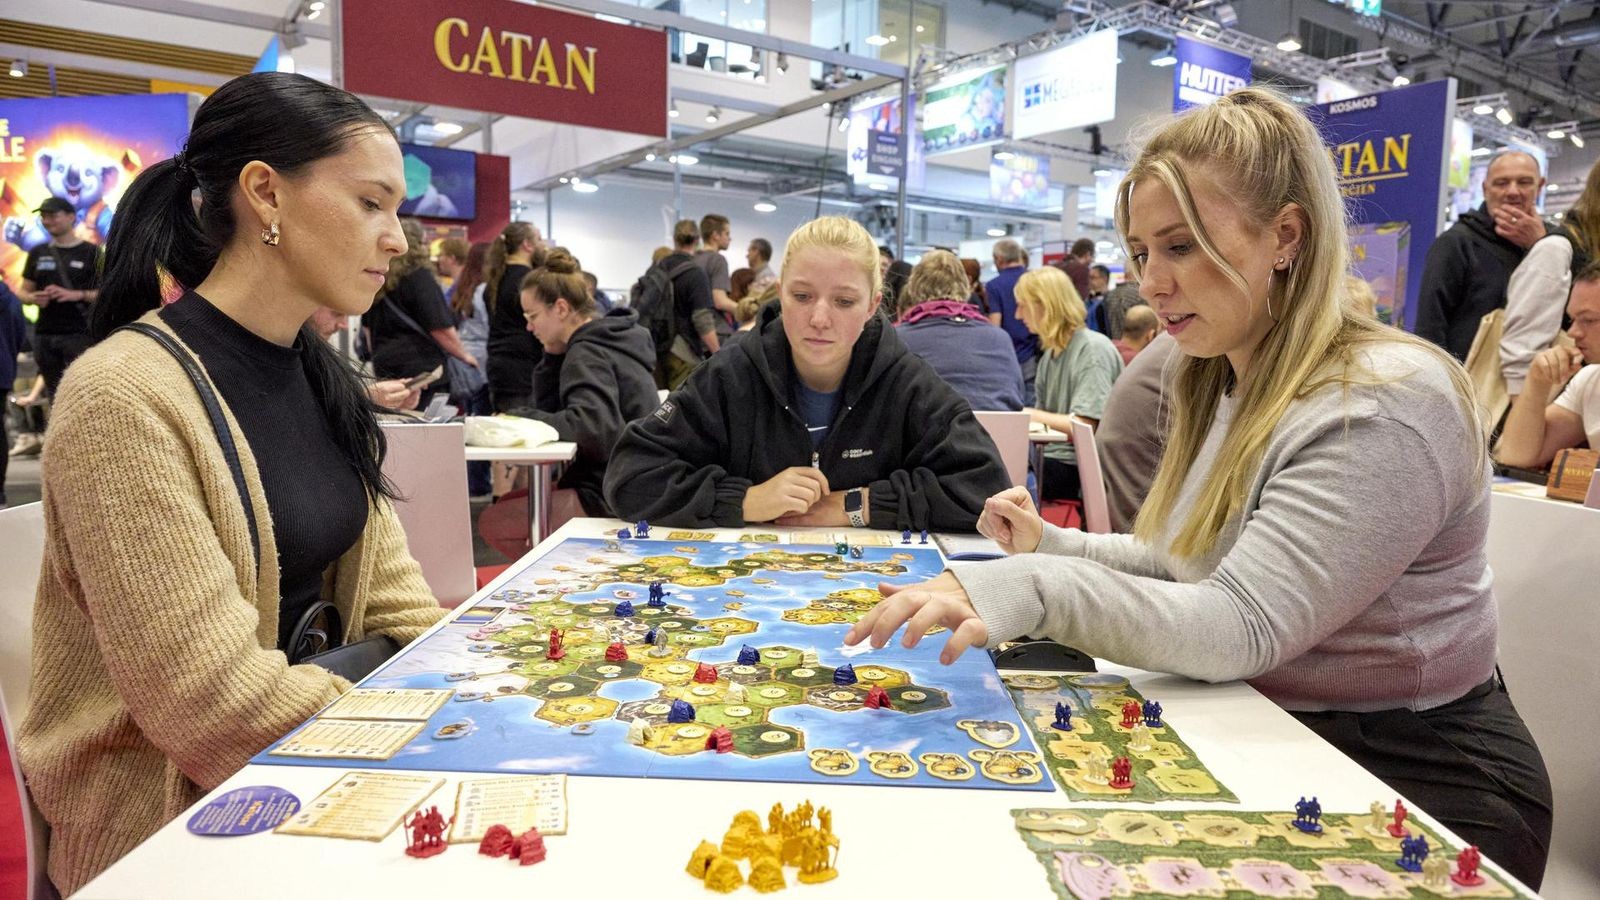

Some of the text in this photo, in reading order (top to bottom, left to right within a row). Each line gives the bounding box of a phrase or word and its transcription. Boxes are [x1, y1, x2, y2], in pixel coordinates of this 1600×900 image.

[434, 17, 598, 95] CATAN
[1329, 96, 1378, 115] KOSMOS
[1327, 133, 1412, 176] TAN
